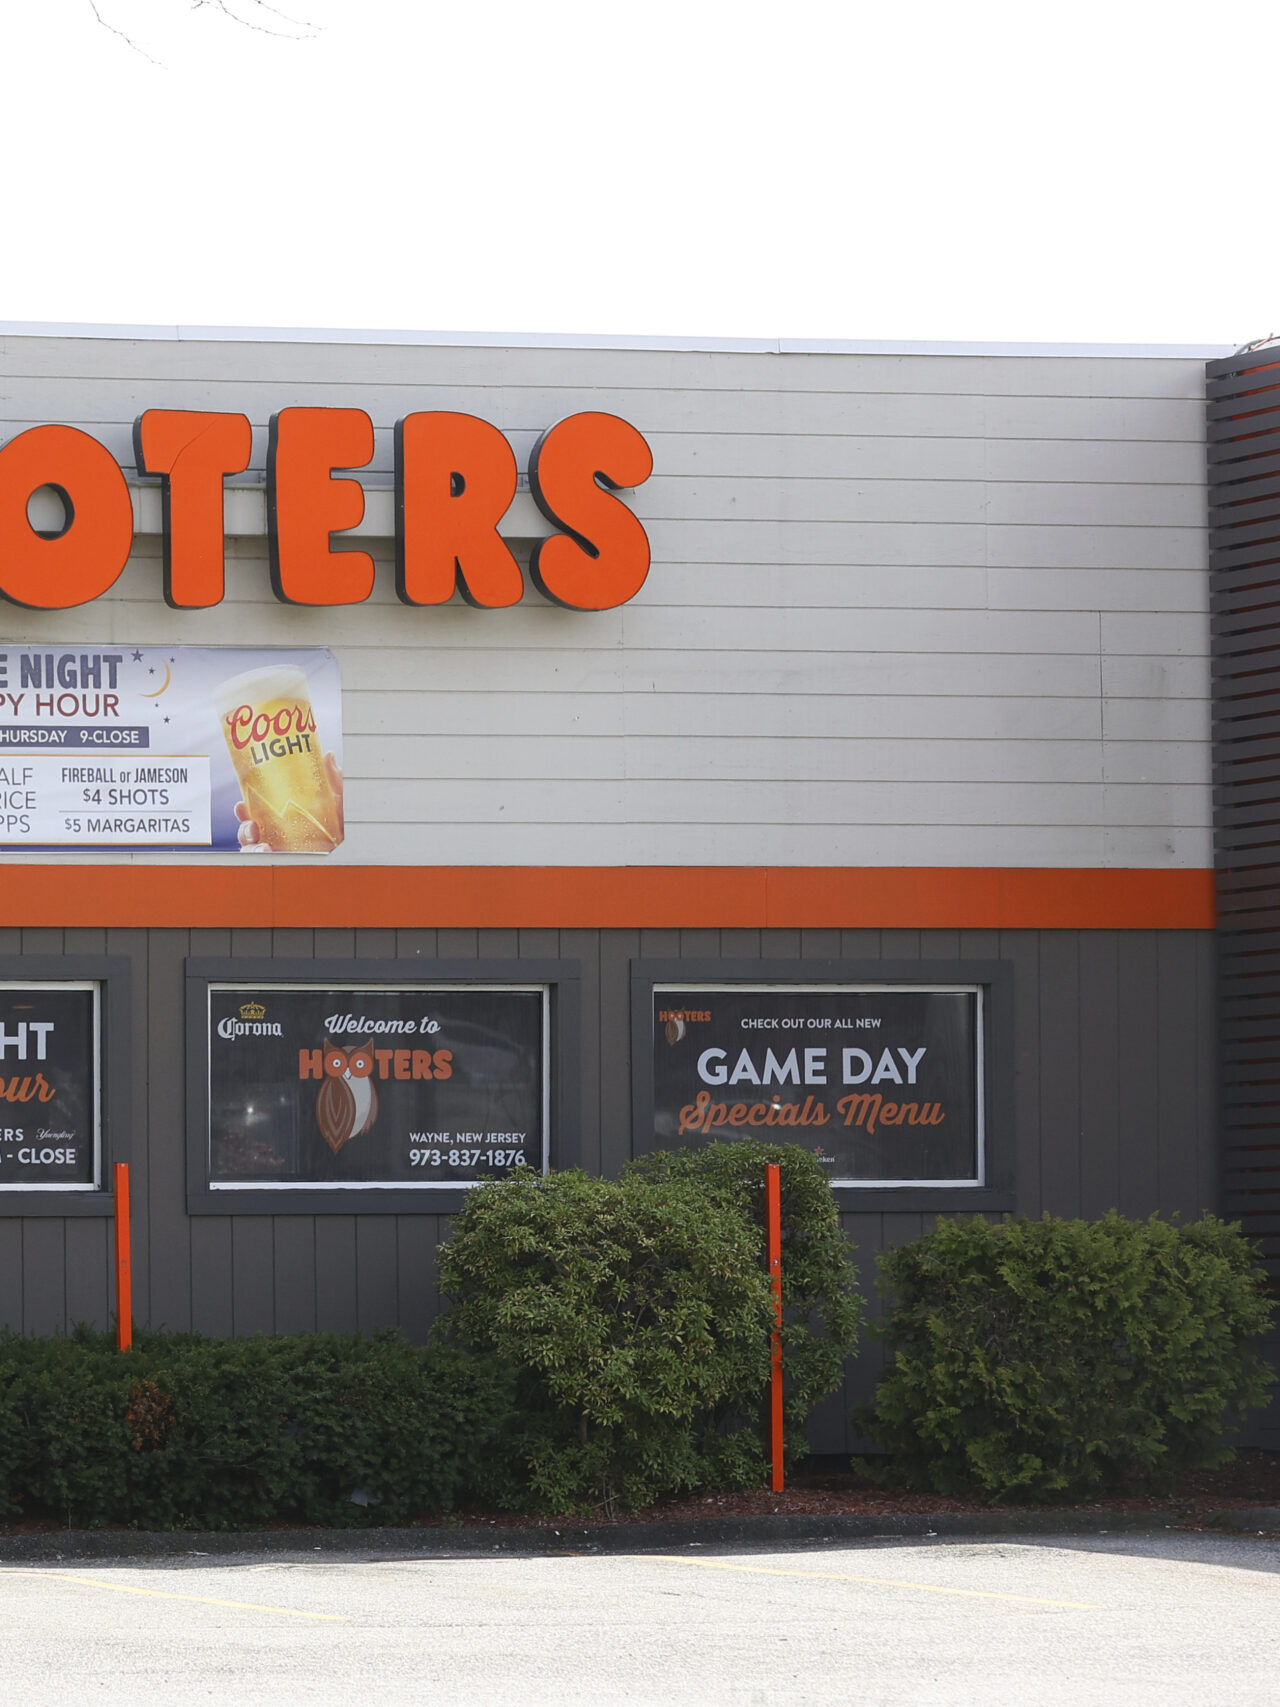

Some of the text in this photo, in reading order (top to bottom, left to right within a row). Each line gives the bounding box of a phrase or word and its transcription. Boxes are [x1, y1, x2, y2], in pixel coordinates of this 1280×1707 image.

[20, 654, 123, 690] NIGHT
[35, 693, 120, 718] HOUR
[225, 704, 317, 750] Coors
[79, 730, 140, 745] 9-CLOSE
[250, 733, 313, 765] LIGHT
[61, 767, 188, 784] FIREBALL or JAMESON
[83, 788, 170, 806] $4 SHOTS
[64, 818, 191, 833] $5 MARGARITAS
[324, 1013, 441, 1035] Welcome to
[658, 1010, 712, 1022] HOOTERS
[740, 1018, 882, 1030] CHECK OUT OUR ALL NEW
[217, 1016, 283, 1040] Corona
[298, 1048, 454, 1081] HOOTERS
[696, 1047, 927, 1086] GAME DAY
[678, 1090, 946, 1135] Specials Menu
[36, 1128, 76, 1140] Yuengling
[409, 1132, 527, 1145] WAYNE, NEW JERSEY
[18, 1148, 76, 1165] CLOSE
[409, 1149, 526, 1167] 973-837-1876
